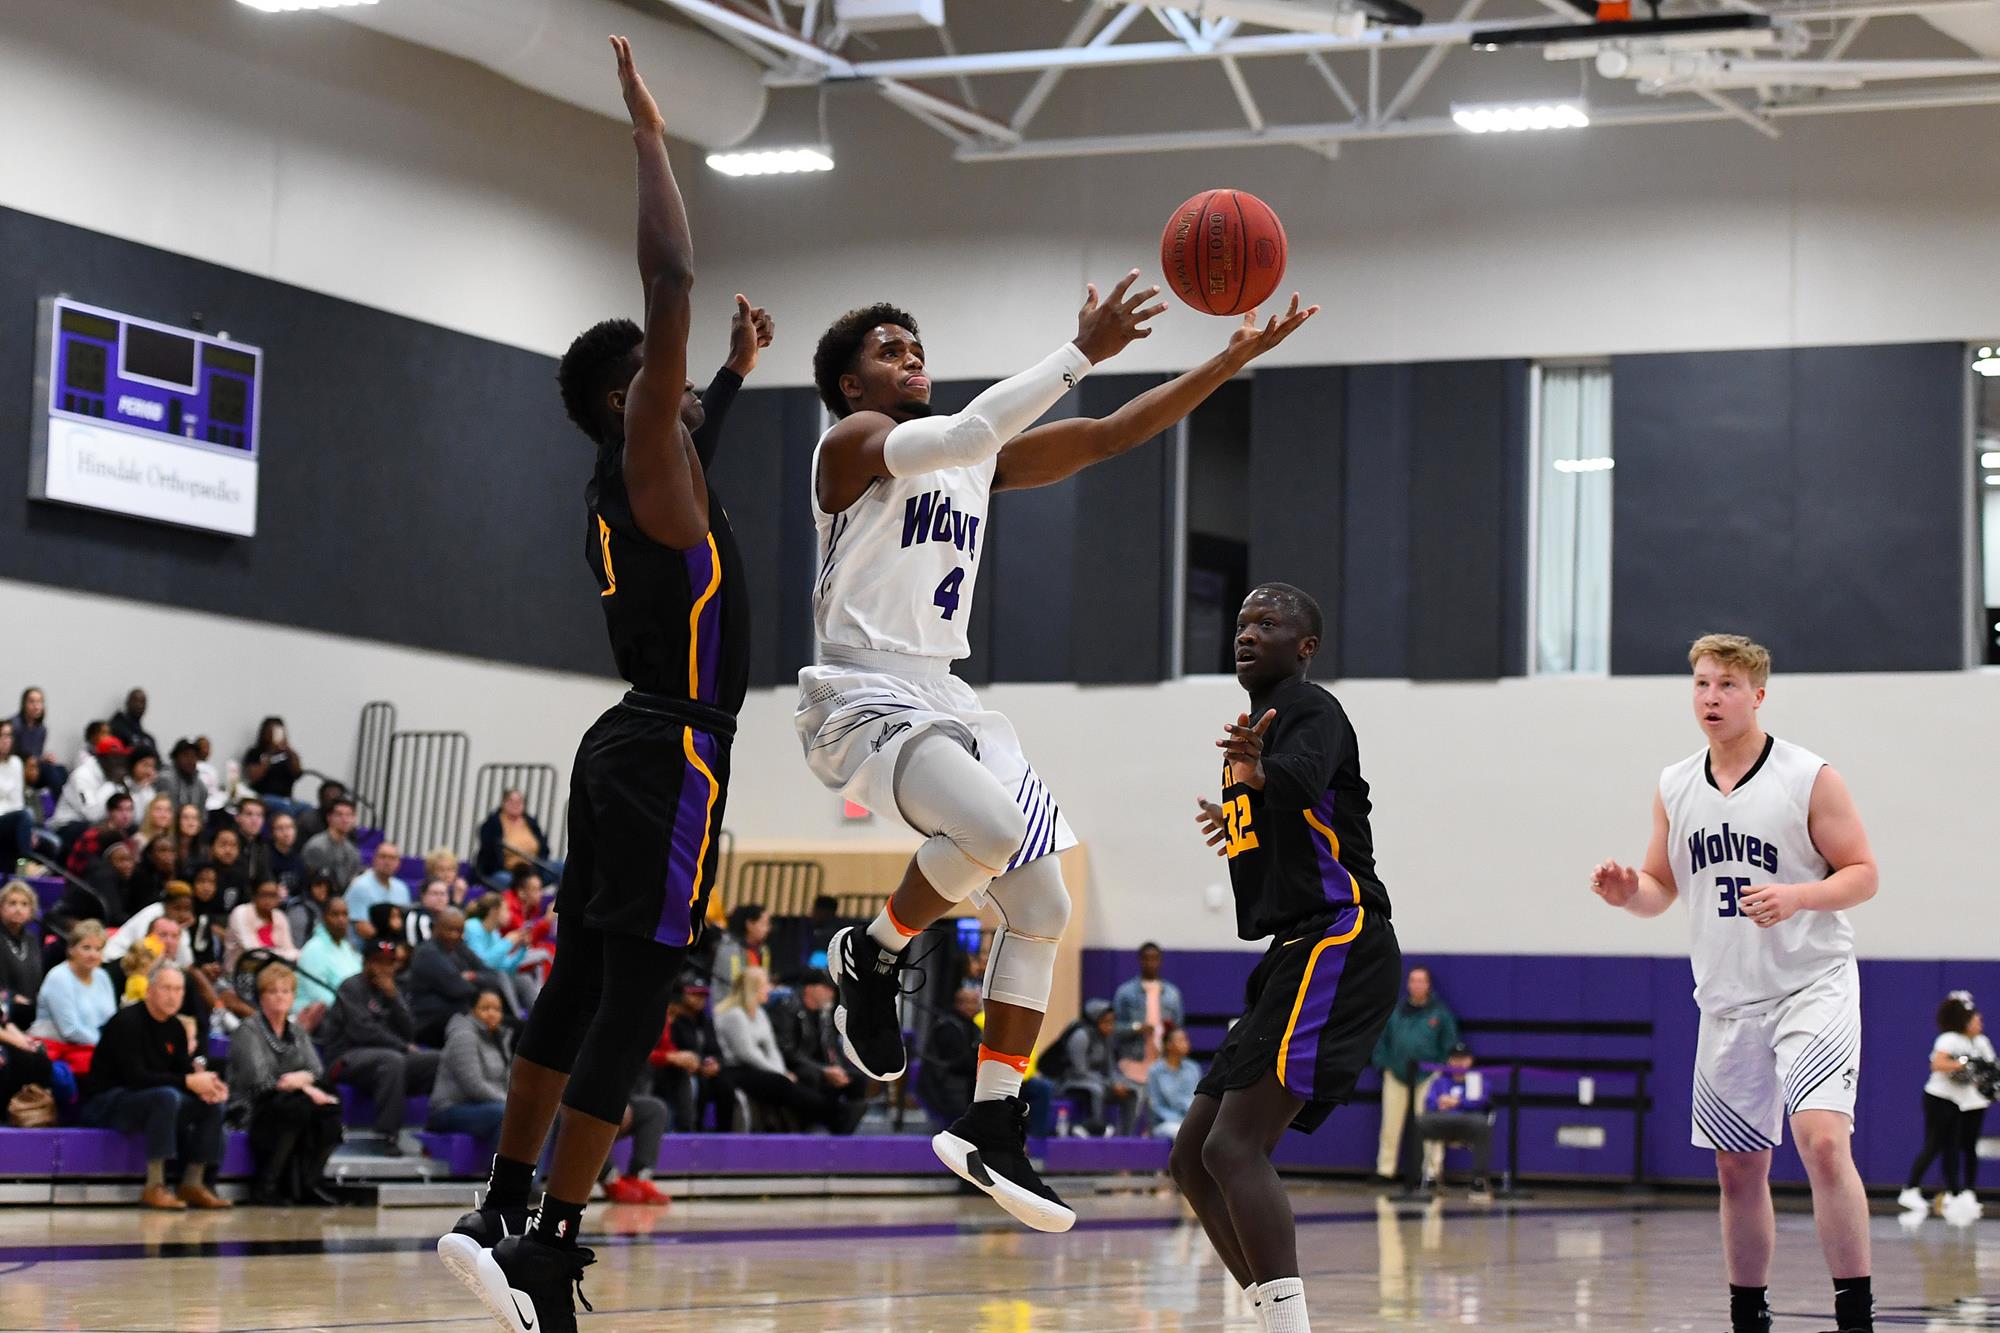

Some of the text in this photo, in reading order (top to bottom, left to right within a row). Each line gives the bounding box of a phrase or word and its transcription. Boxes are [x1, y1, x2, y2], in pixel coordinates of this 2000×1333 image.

[933, 567, 965, 621] 4
[1222, 794, 1260, 859] 32
[1688, 822, 1778, 875] Wolves
